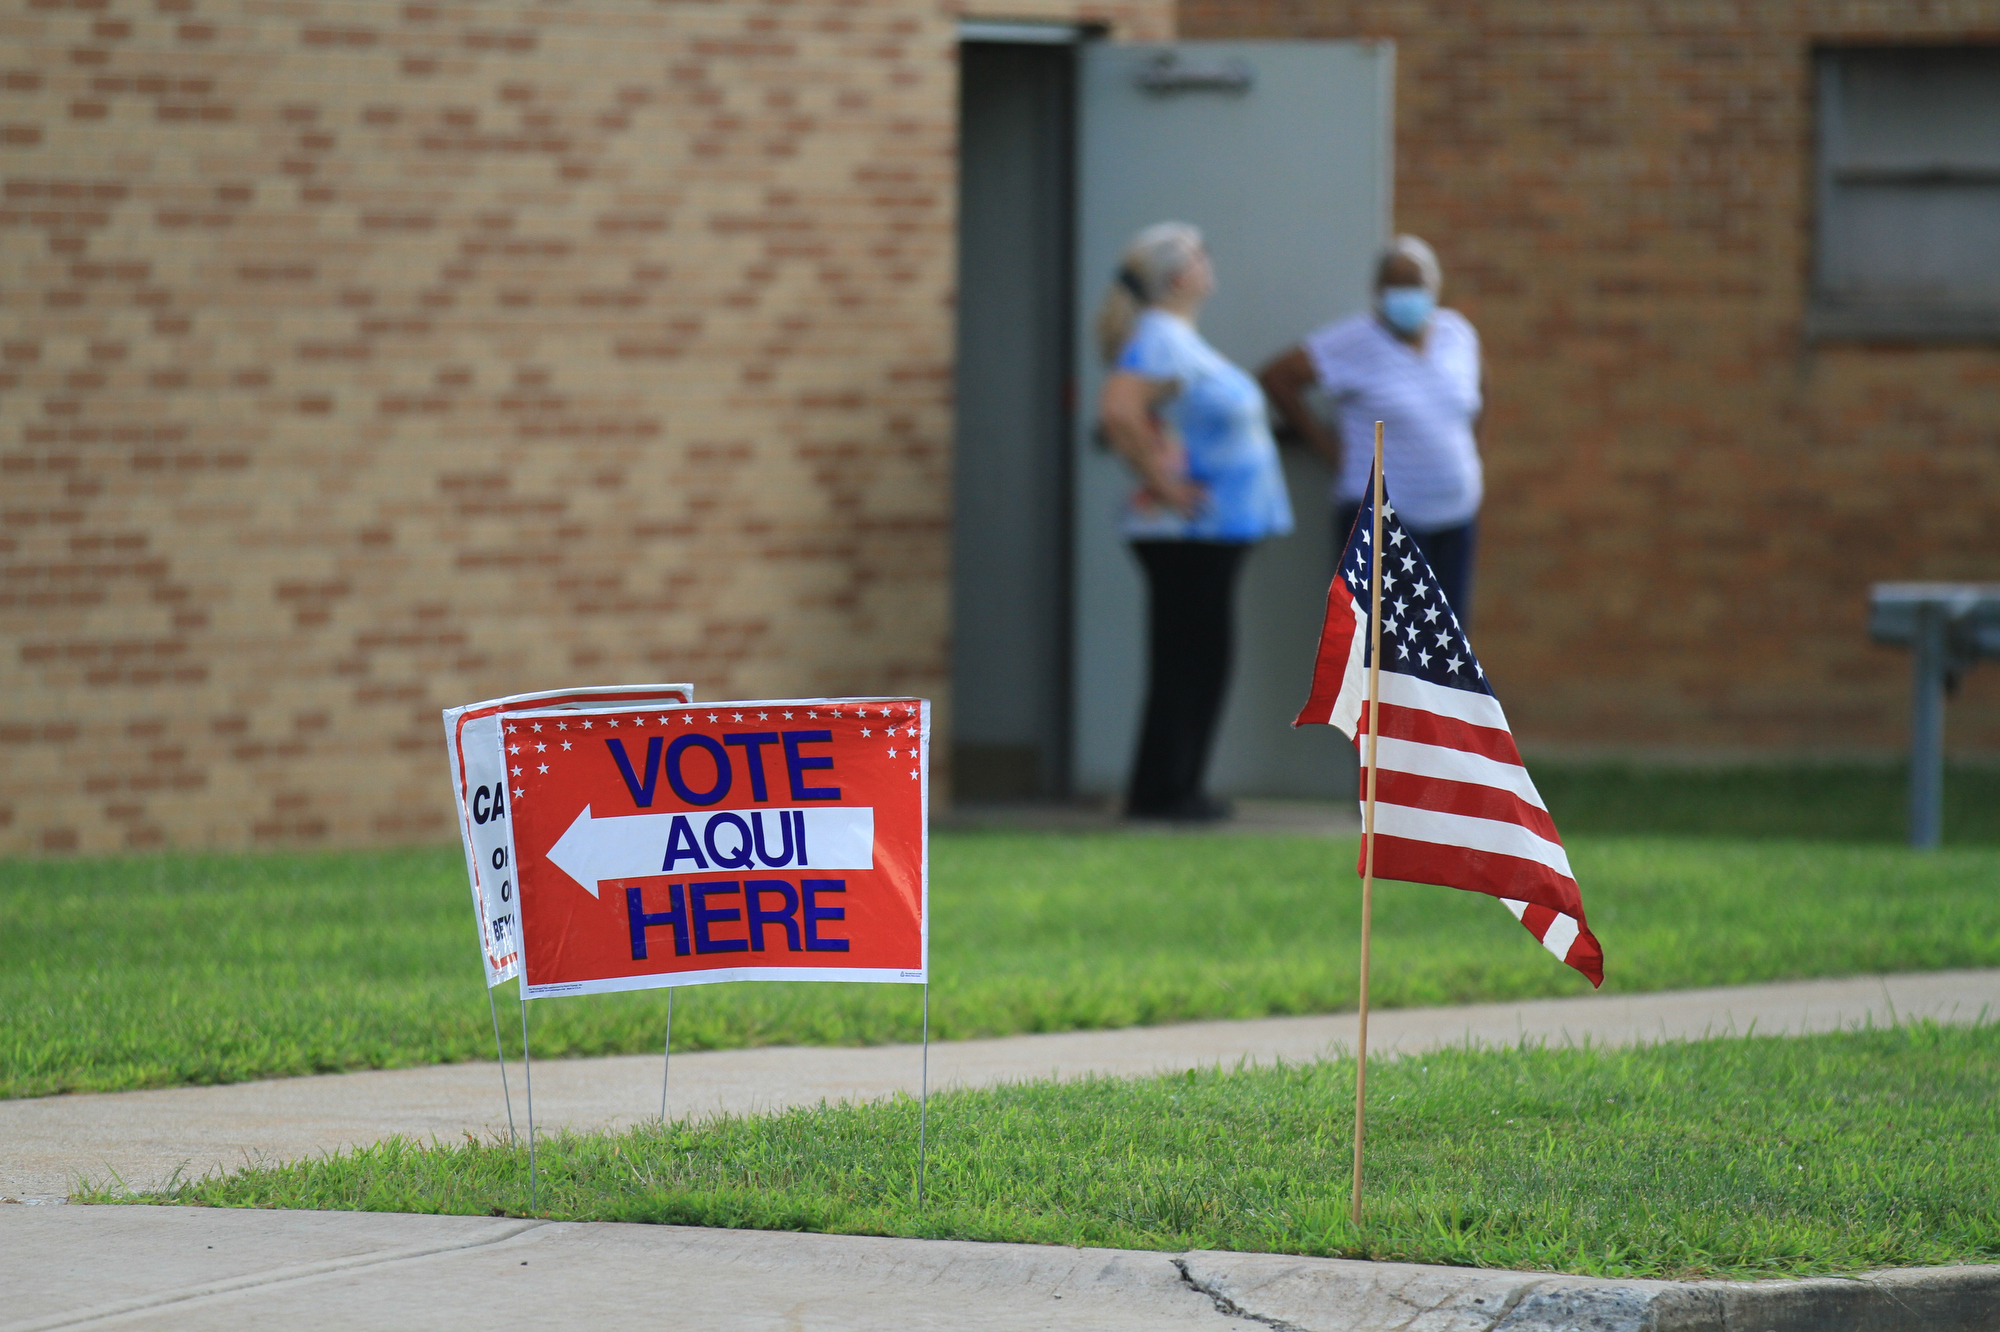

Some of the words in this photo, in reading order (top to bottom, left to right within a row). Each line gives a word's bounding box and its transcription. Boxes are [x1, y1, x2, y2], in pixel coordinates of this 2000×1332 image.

[604, 730, 841, 808] VOTE
[662, 811, 808, 871] AQUI
[626, 879, 850, 961] HERE
